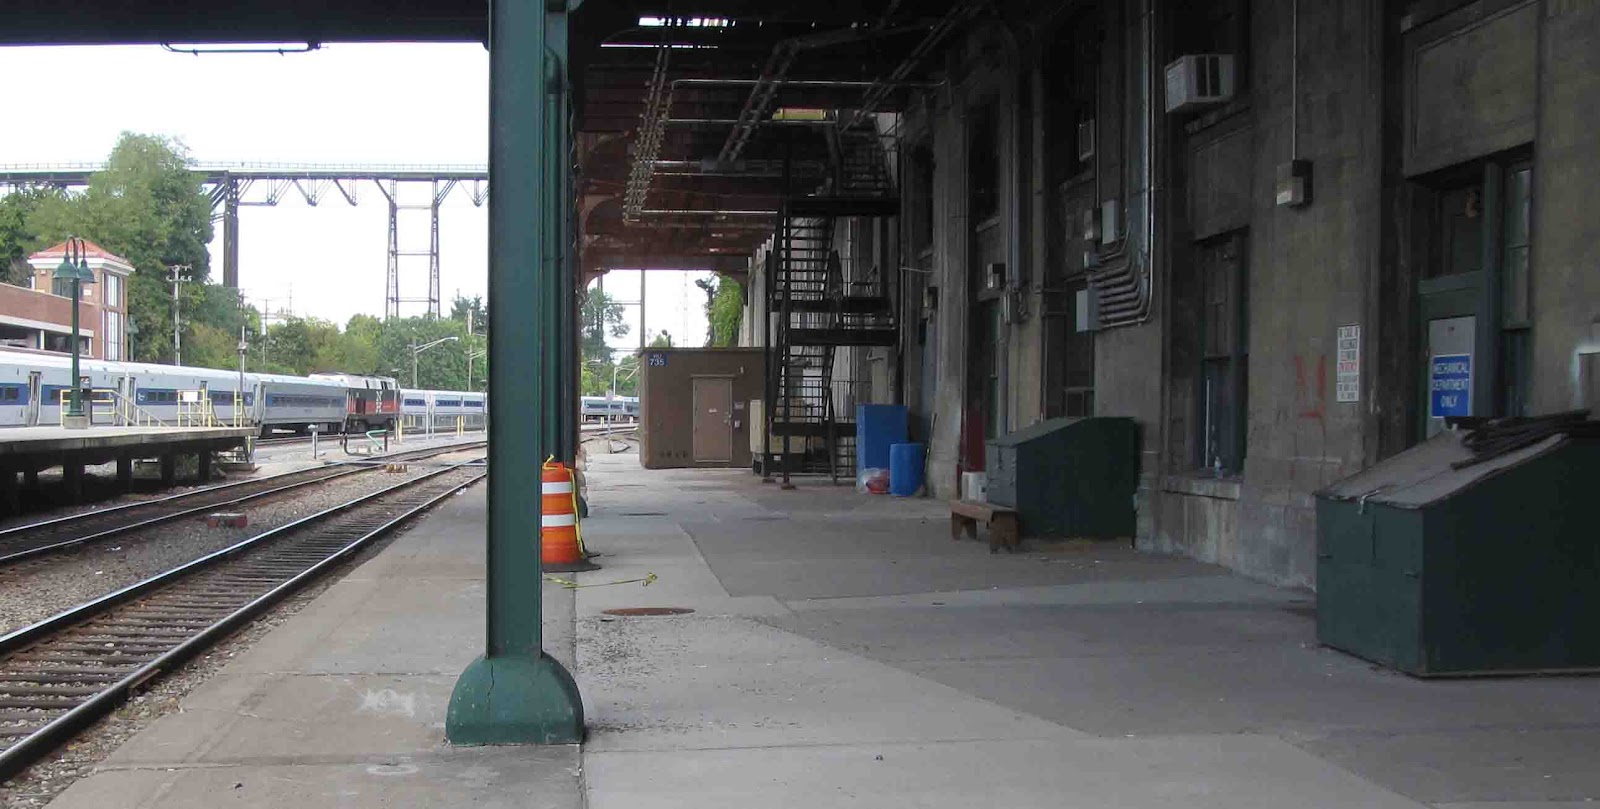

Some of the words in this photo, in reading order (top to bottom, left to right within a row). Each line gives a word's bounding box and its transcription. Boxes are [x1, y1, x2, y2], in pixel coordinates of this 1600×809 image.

[650, 358, 665, 366] 735
[1433, 362, 1469, 374] MECHANICAL
[1432, 378, 1469, 391] DEPARTMENT
[1440, 395, 1458, 408] ONLY
